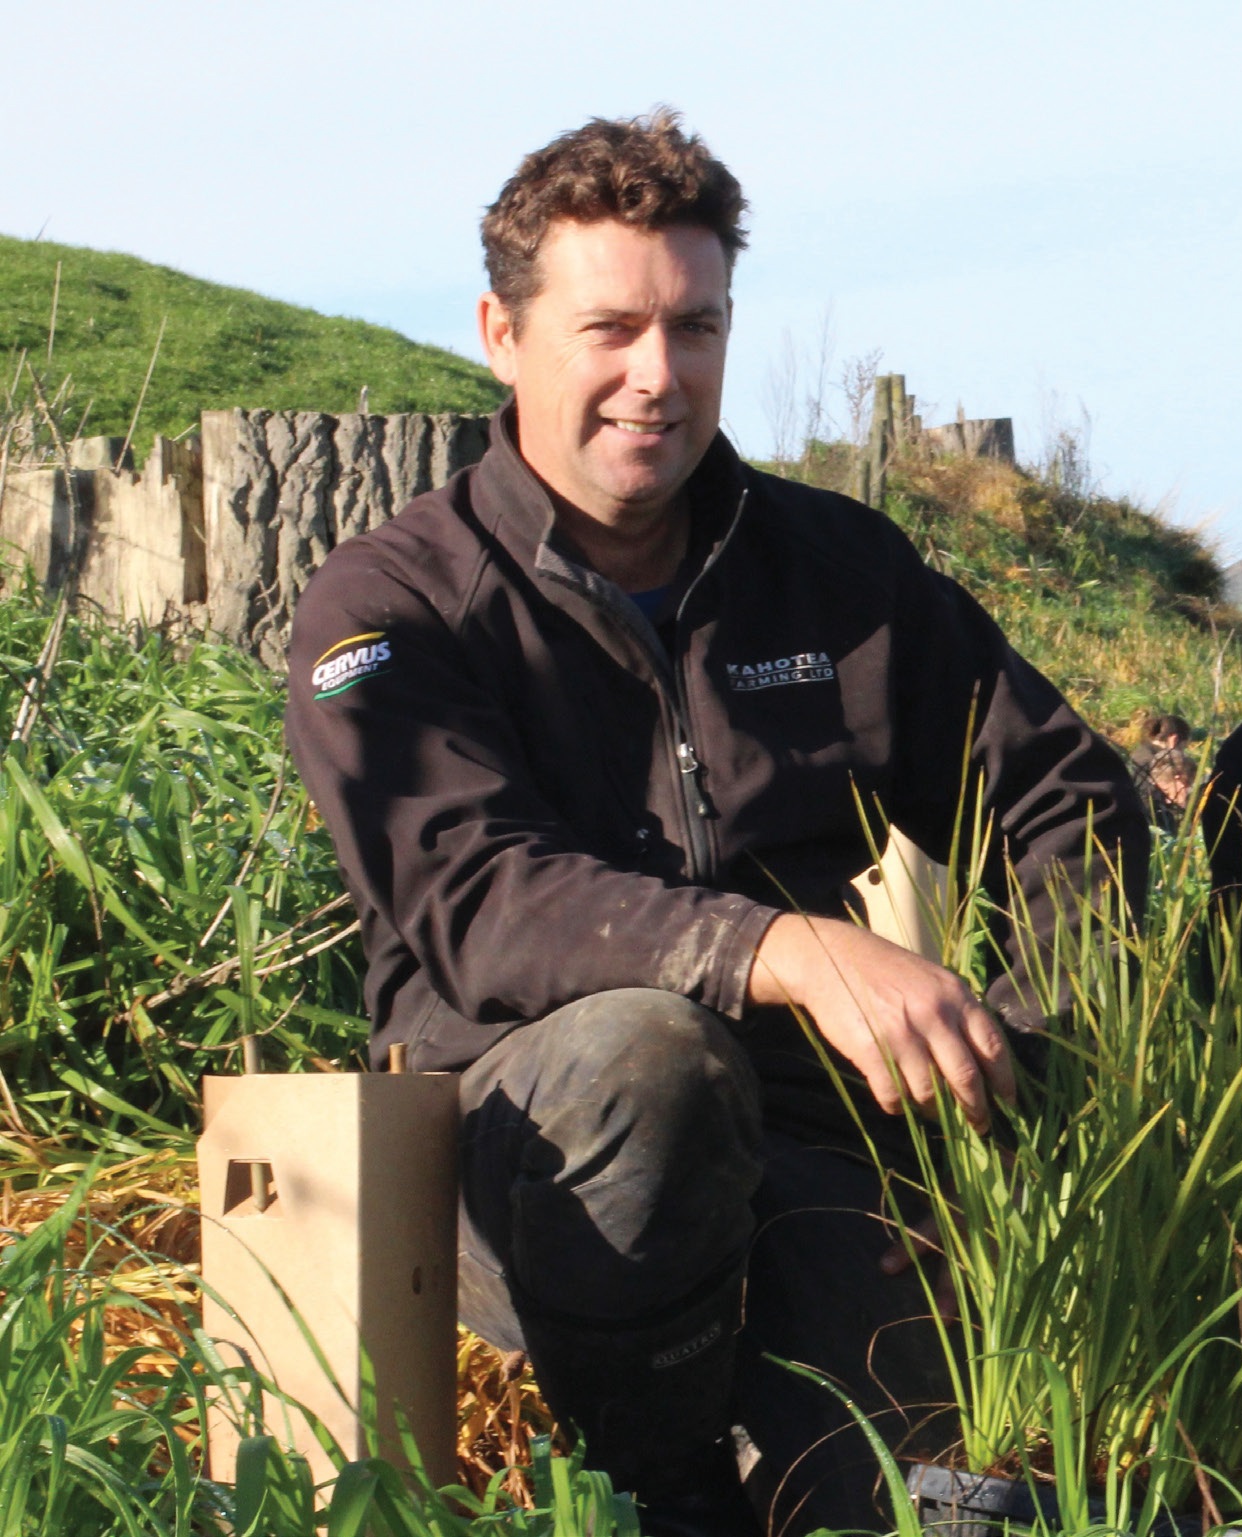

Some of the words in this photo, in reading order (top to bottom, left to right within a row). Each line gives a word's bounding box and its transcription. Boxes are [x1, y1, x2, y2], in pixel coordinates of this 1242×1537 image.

[312, 641, 391, 685] CERVUS
[726, 652, 830, 676] KAHOTEA
[810, 668, 834, 678] LTD
